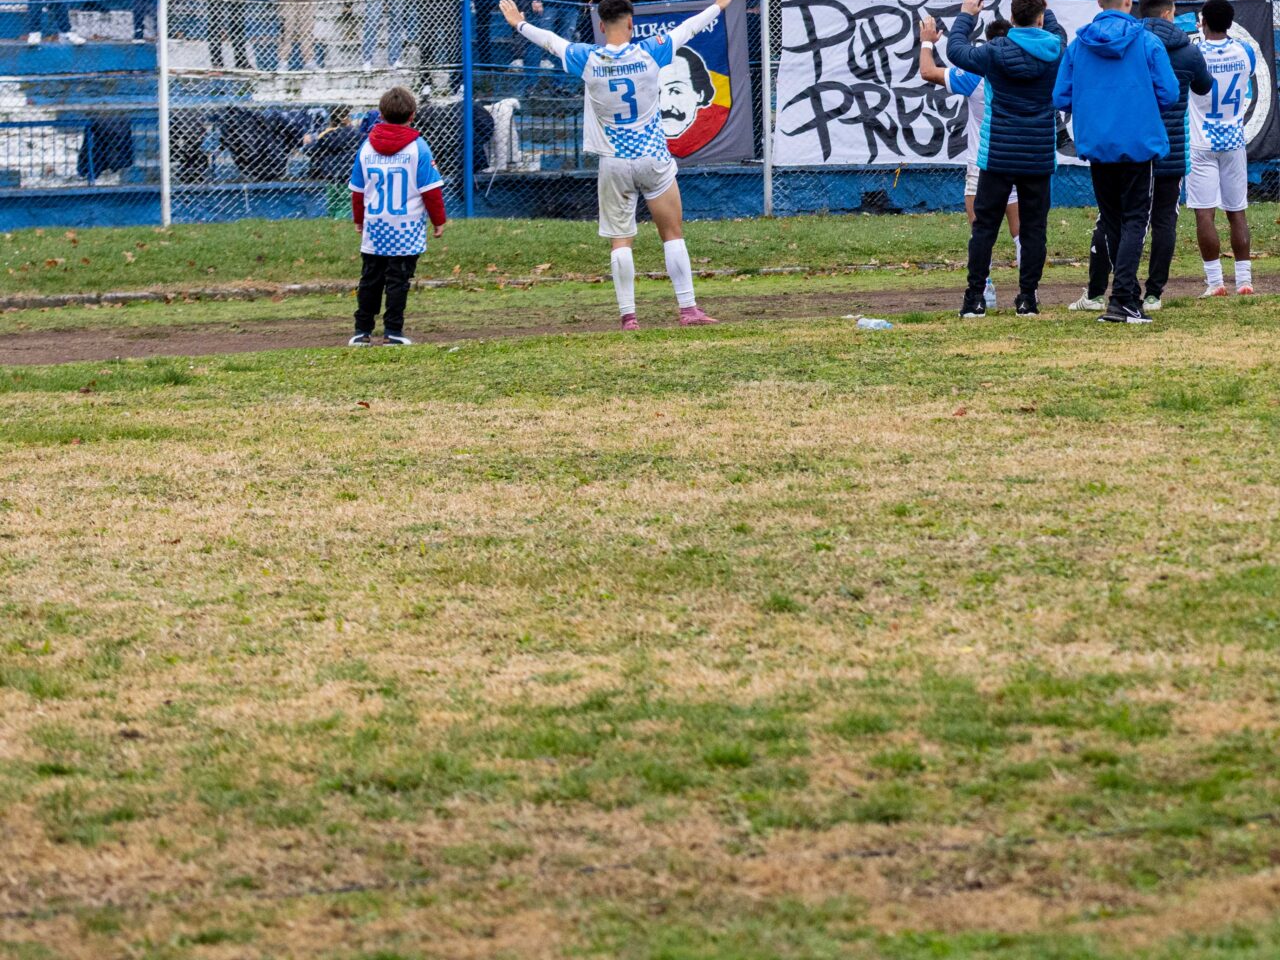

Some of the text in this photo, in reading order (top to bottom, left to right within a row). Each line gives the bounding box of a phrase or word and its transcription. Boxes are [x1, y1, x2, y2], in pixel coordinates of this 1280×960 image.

[631, 21, 677, 39] LTRAS
[592, 62, 648, 78] HUNEDOARA
[1207, 59, 1246, 74] NEDOARA
[608, 77, 639, 125] 3
[1205, 72, 1241, 119] 14
[366, 166, 409, 216] 30
